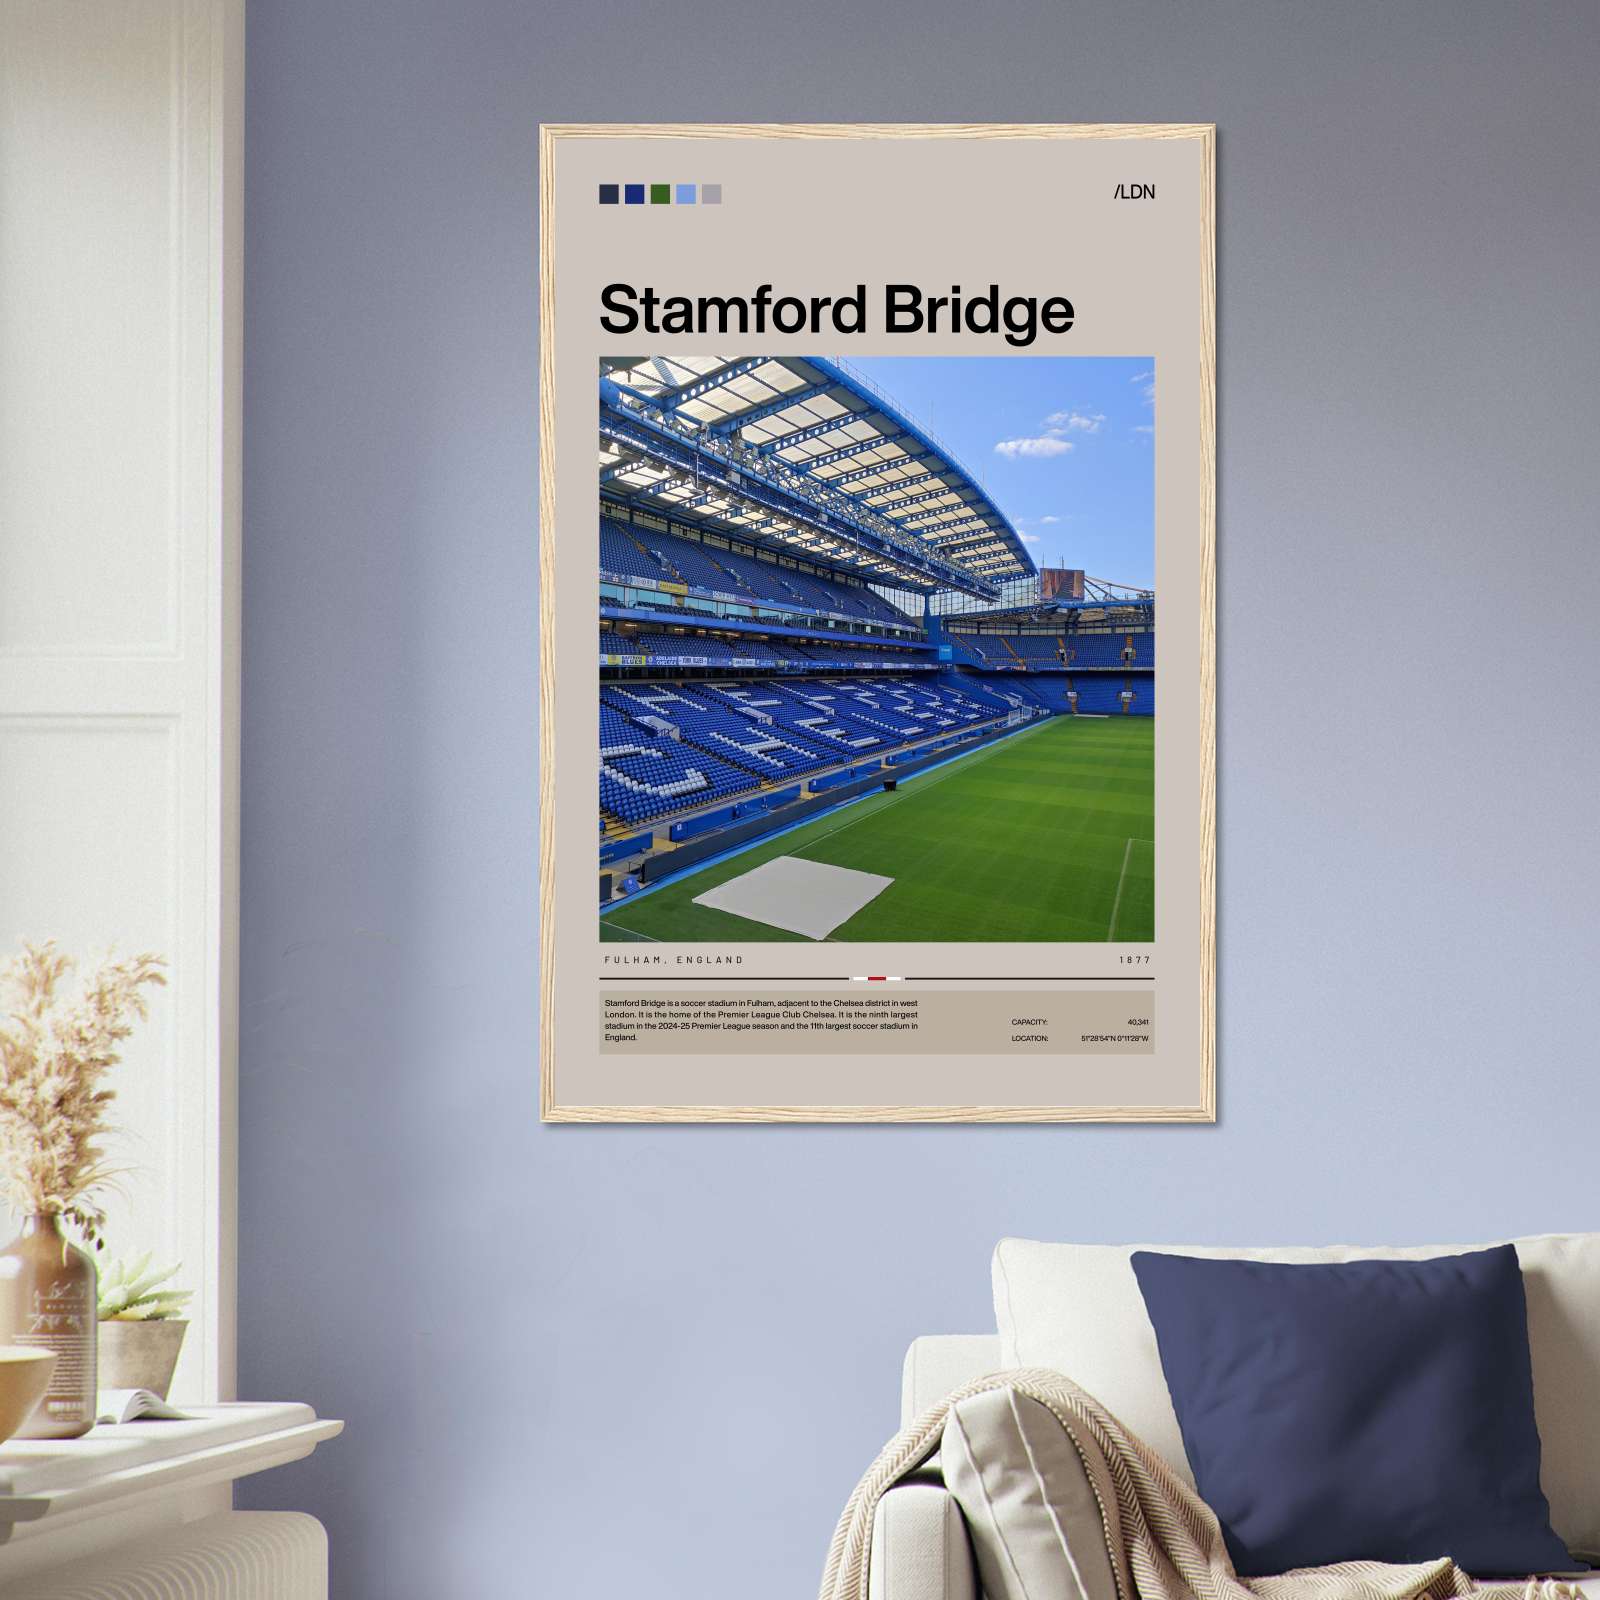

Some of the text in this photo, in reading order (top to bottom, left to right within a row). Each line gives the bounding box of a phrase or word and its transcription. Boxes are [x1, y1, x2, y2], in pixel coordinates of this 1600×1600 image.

[1113, 183, 1156, 200] /LDN
[600, 284, 1074, 347] Stamford Bridge
[604, 955, 742, 965] FULHAM, ENGLAND
[1119, 955, 1150, 965] 1877
[605, 999, 639, 1007] Stamford
[641, 999, 665, 1009] Bridge
[667, 999, 674, 1007] is
[708, 999, 737, 1007] stadium
[739, 999, 745, 1007] in
[747, 999, 776, 1009] Fulham,
[778, 999, 809, 1009] adjacent
[810, 999, 818, 1007] to
[820, 999, 832, 1007] the
[834, 999, 864, 1007] Chelsea
[865, 999, 890, 1007] district
[892, 999, 898, 1007] in
[900, 999, 918, 1007] west
[752, 1011, 780, 1020] League
[891, 1011, 917, 1020] largest
[605, 1022, 634, 1030] stadium
[636, 1022, 643, 1030] in
[645, 1022, 656, 1030] the
[658, 1022, 690, 1030] 2024-25
[692, 1022, 721, 1030] Premier
[723, 1022, 750, 1032] League
[781, 1022, 794, 1030] and
[797, 1022, 808, 1030] the
[811, 1022, 824, 1030] 11th
[826, 1022, 851, 1032] largest
[880, 1022, 909, 1030] stadium
[912, 1022, 918, 1030] in
[1011, 1018, 1048, 1026] CAPACITY:
[605, 1034, 638, 1042] England.
[1011, 1034, 1048, 1042] LOCATION:
